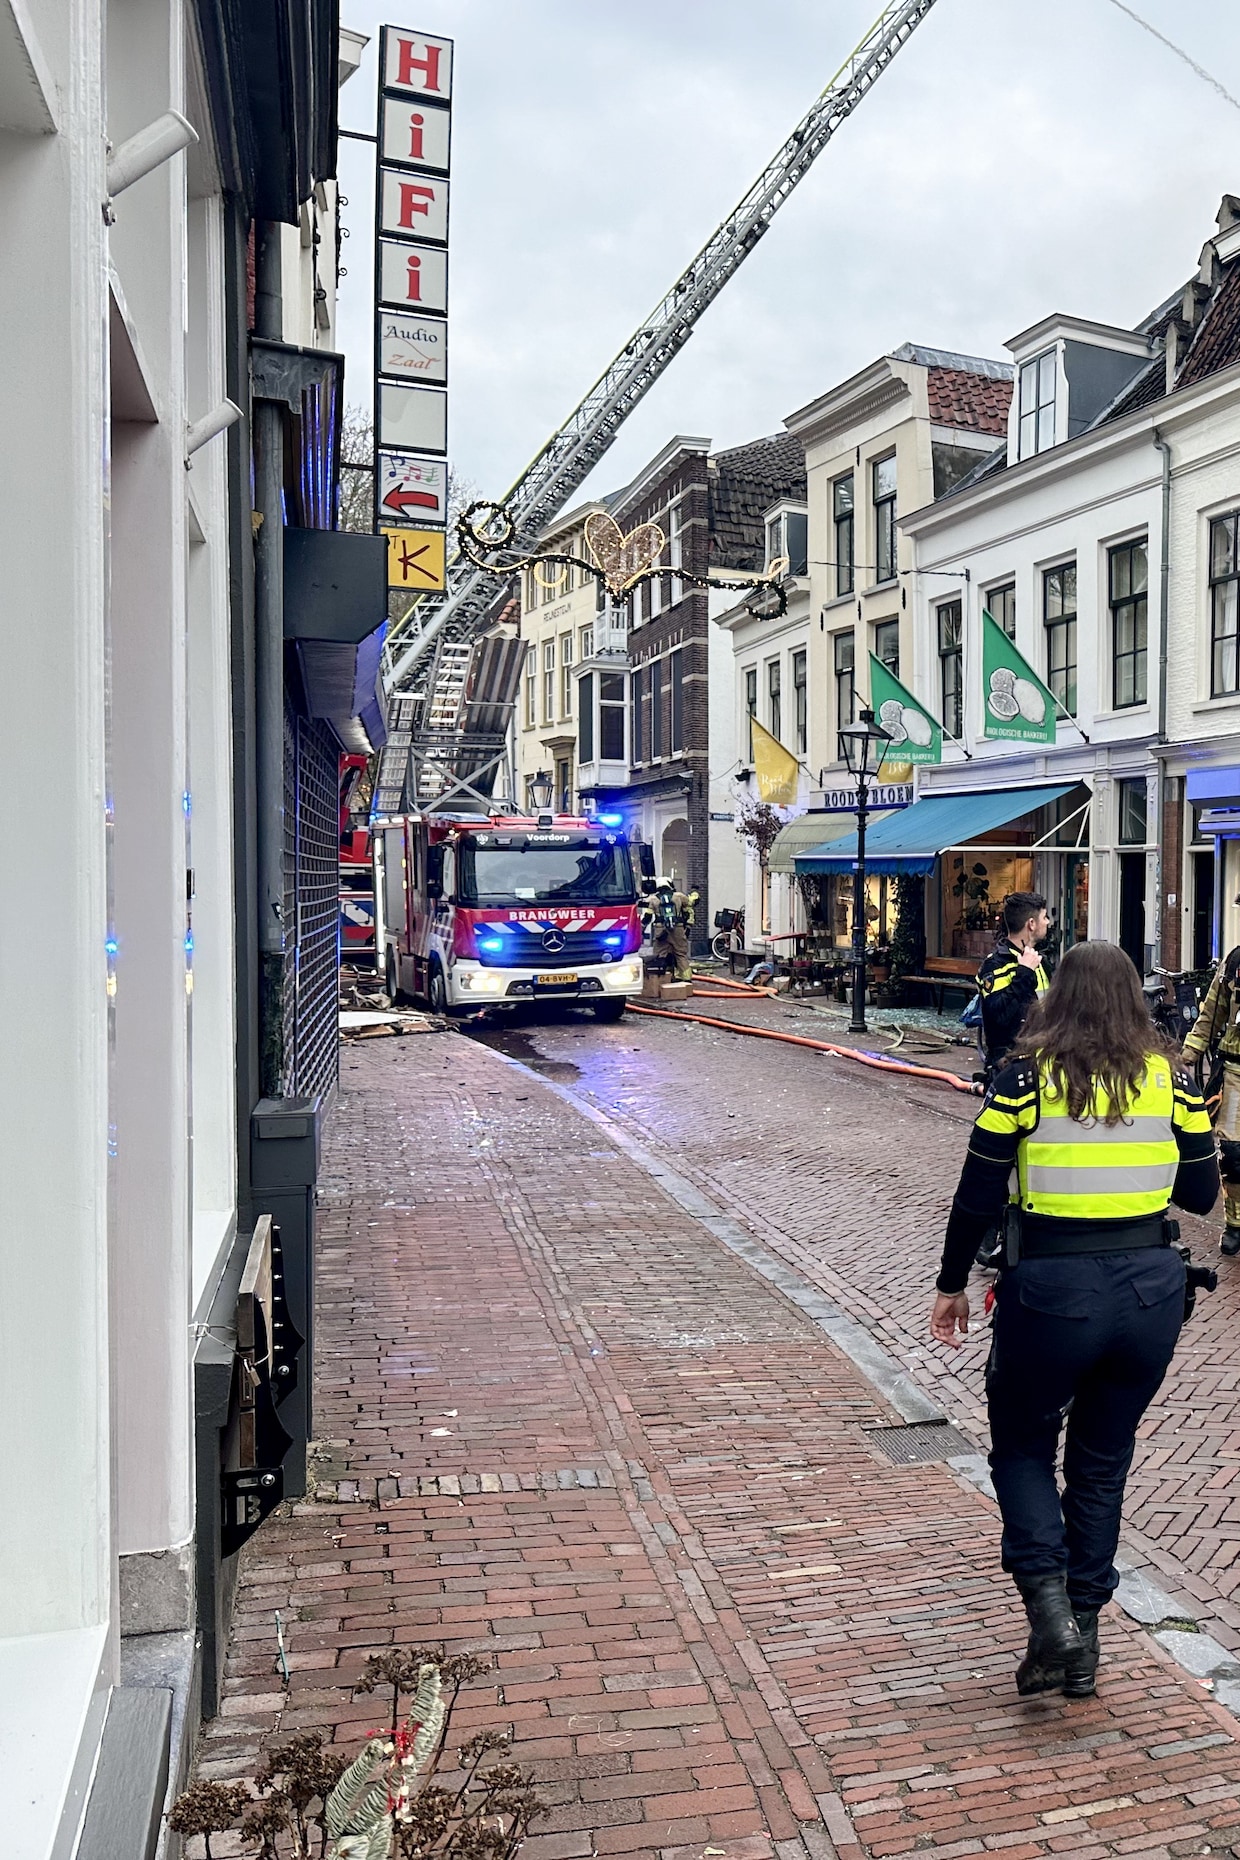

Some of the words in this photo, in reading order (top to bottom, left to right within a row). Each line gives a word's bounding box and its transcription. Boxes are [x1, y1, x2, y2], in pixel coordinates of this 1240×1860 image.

[383, 326, 438, 343] Audio
[388, 354, 441, 369] Zaal
[526, 833, 570, 842] Voordorp
[509, 909, 595, 921] BRANDWEER
[539, 974, 575, 983] 04-BVH-7
